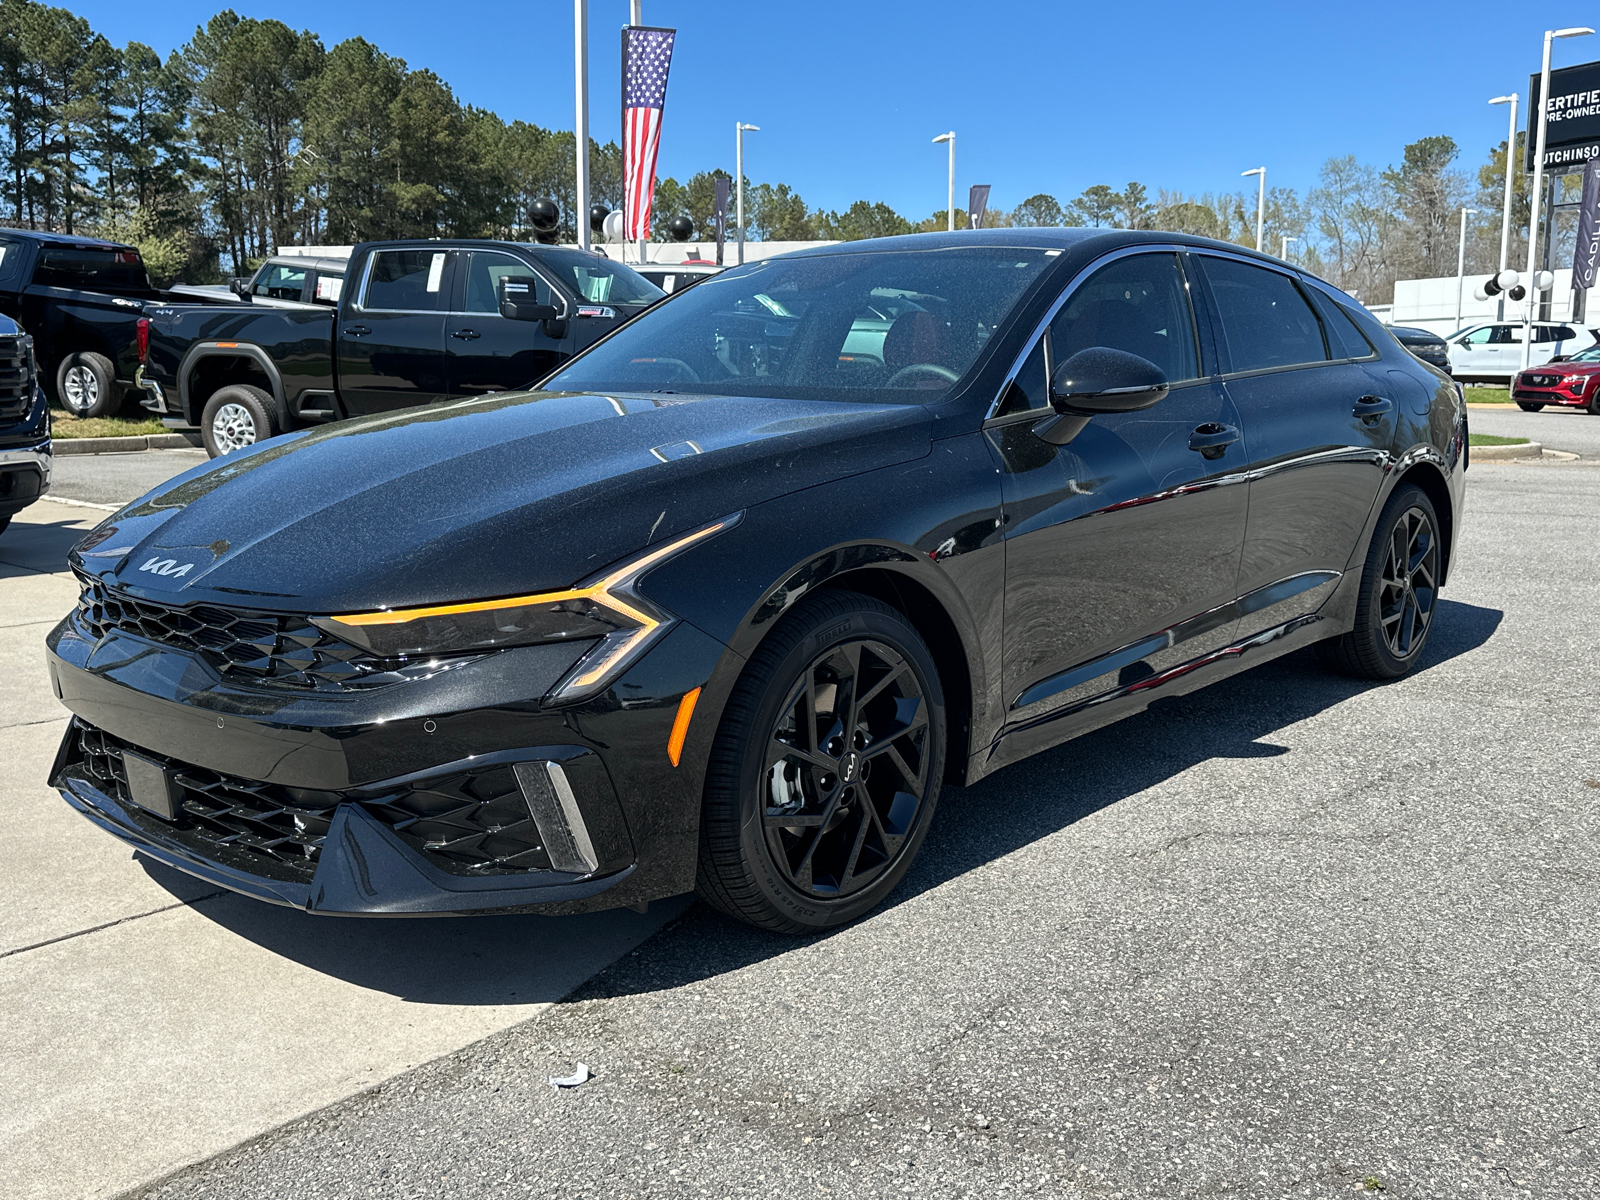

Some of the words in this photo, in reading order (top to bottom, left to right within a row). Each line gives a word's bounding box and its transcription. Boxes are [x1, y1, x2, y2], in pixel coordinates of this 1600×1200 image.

[1538, 89, 1600, 112] ERTIFIE
[1534, 145, 1600, 165] UTCHINSO
[814, 617, 852, 647] PIRELLI
[766, 877, 783, 896] R18
[781, 895, 818, 918] 235/45
